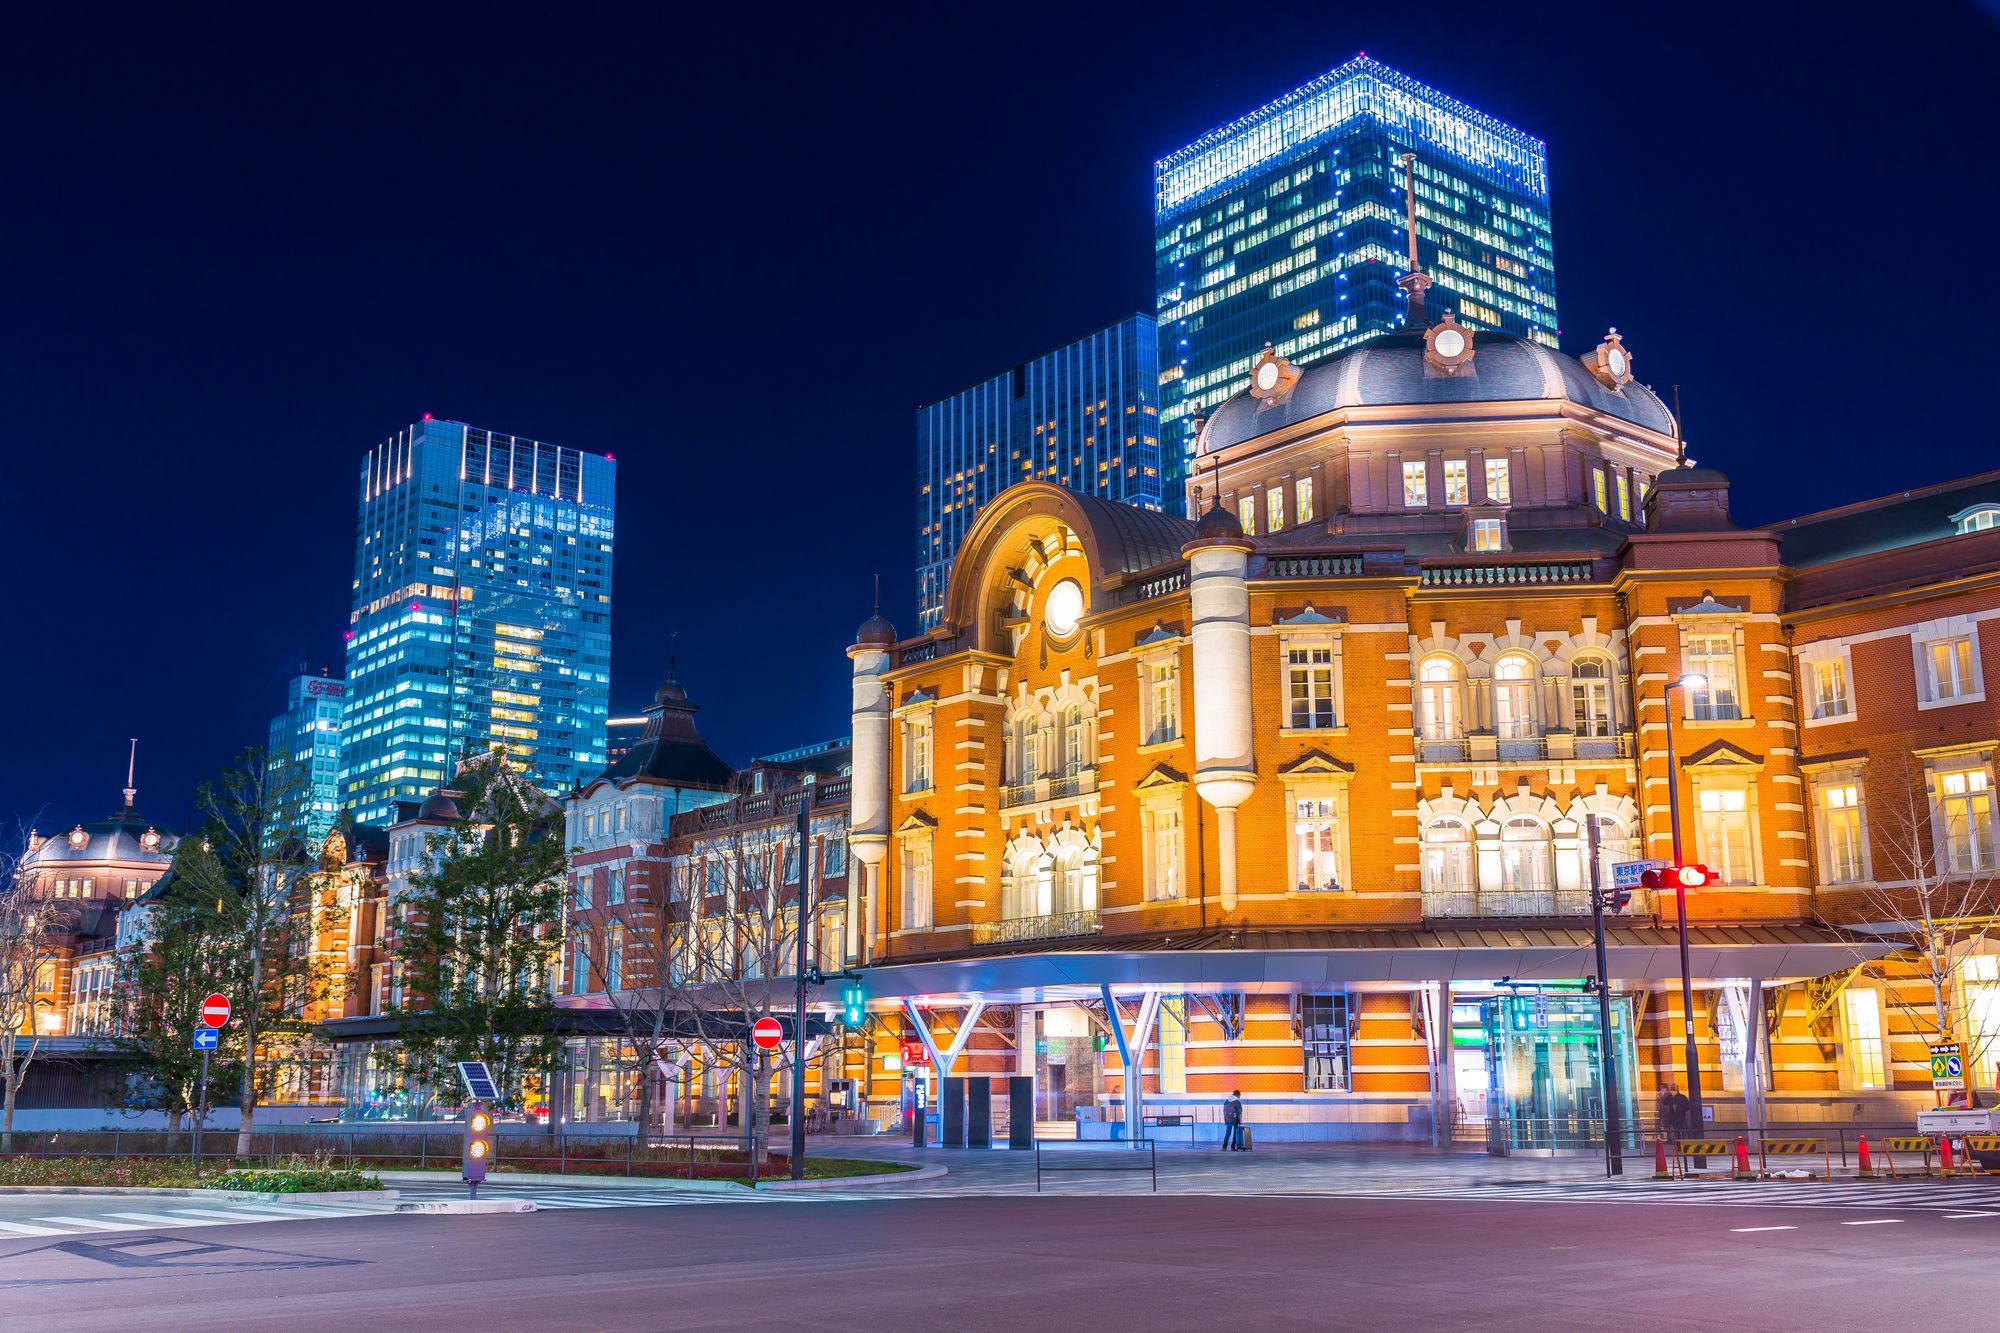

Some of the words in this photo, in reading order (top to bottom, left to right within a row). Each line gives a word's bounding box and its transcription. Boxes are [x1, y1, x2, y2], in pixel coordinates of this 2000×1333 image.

[1616, 863, 1652, 877] 東京駅南口
